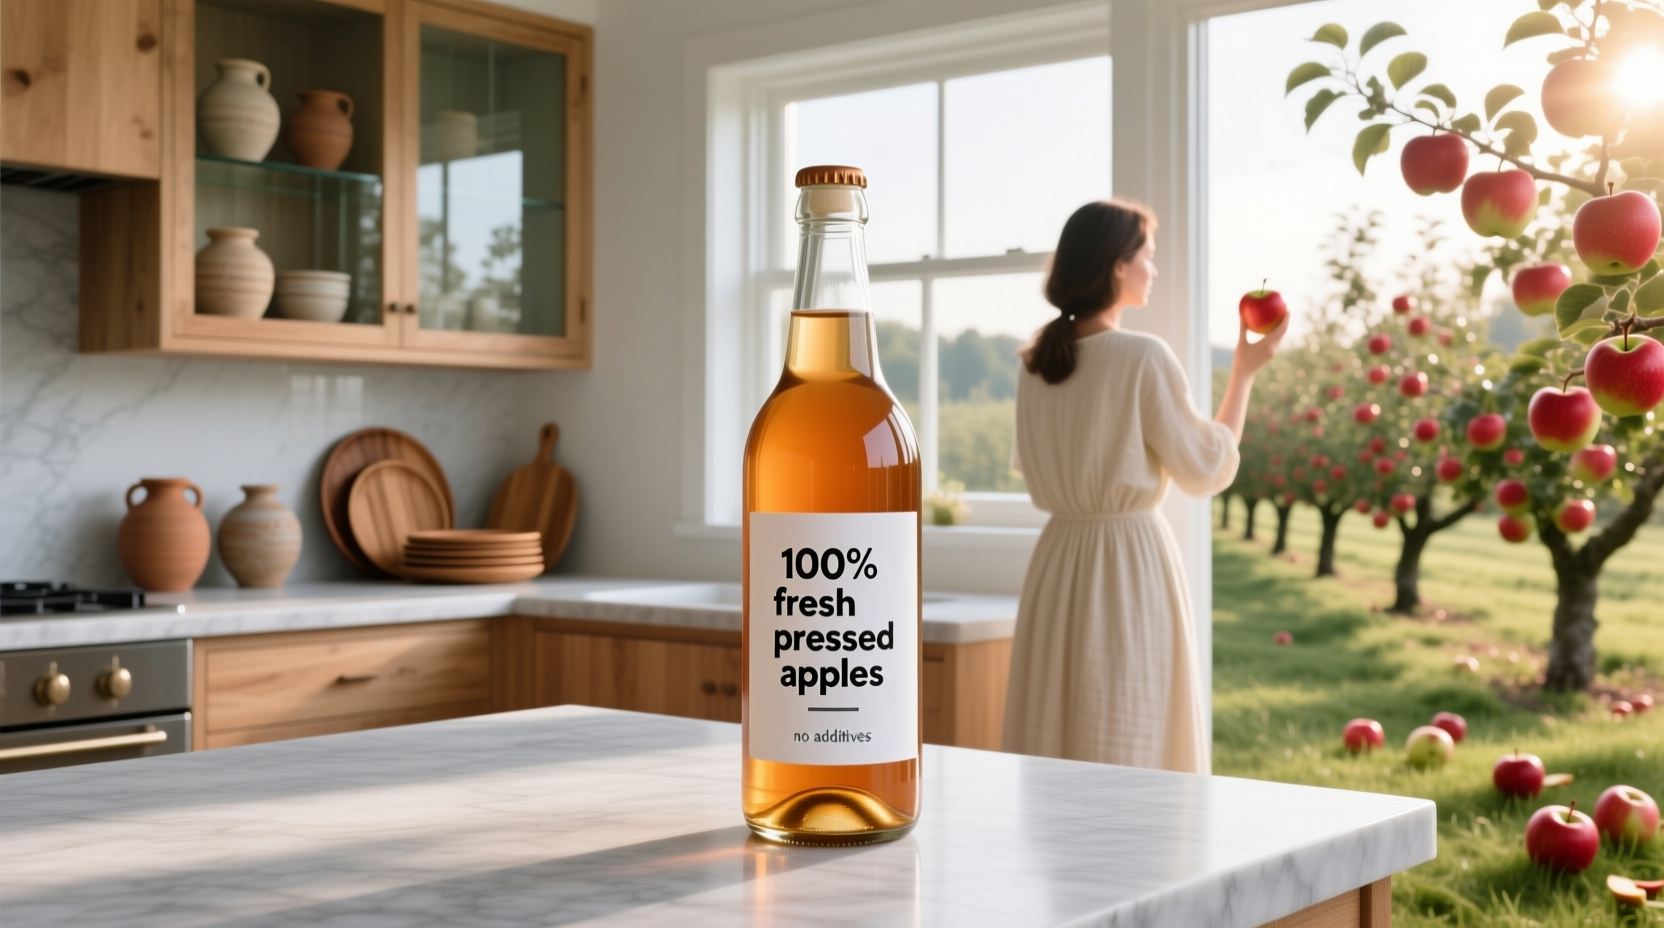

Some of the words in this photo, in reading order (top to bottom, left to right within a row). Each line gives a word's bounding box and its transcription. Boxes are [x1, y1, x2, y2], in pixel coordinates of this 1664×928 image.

[781, 547, 878, 580] 100%
[773, 586, 856, 617] fresh
[773, 621, 894, 658] pressed
[780, 658, 884, 695] apples
[794, 732, 810, 743] no
[814, 729, 872, 743] additives
